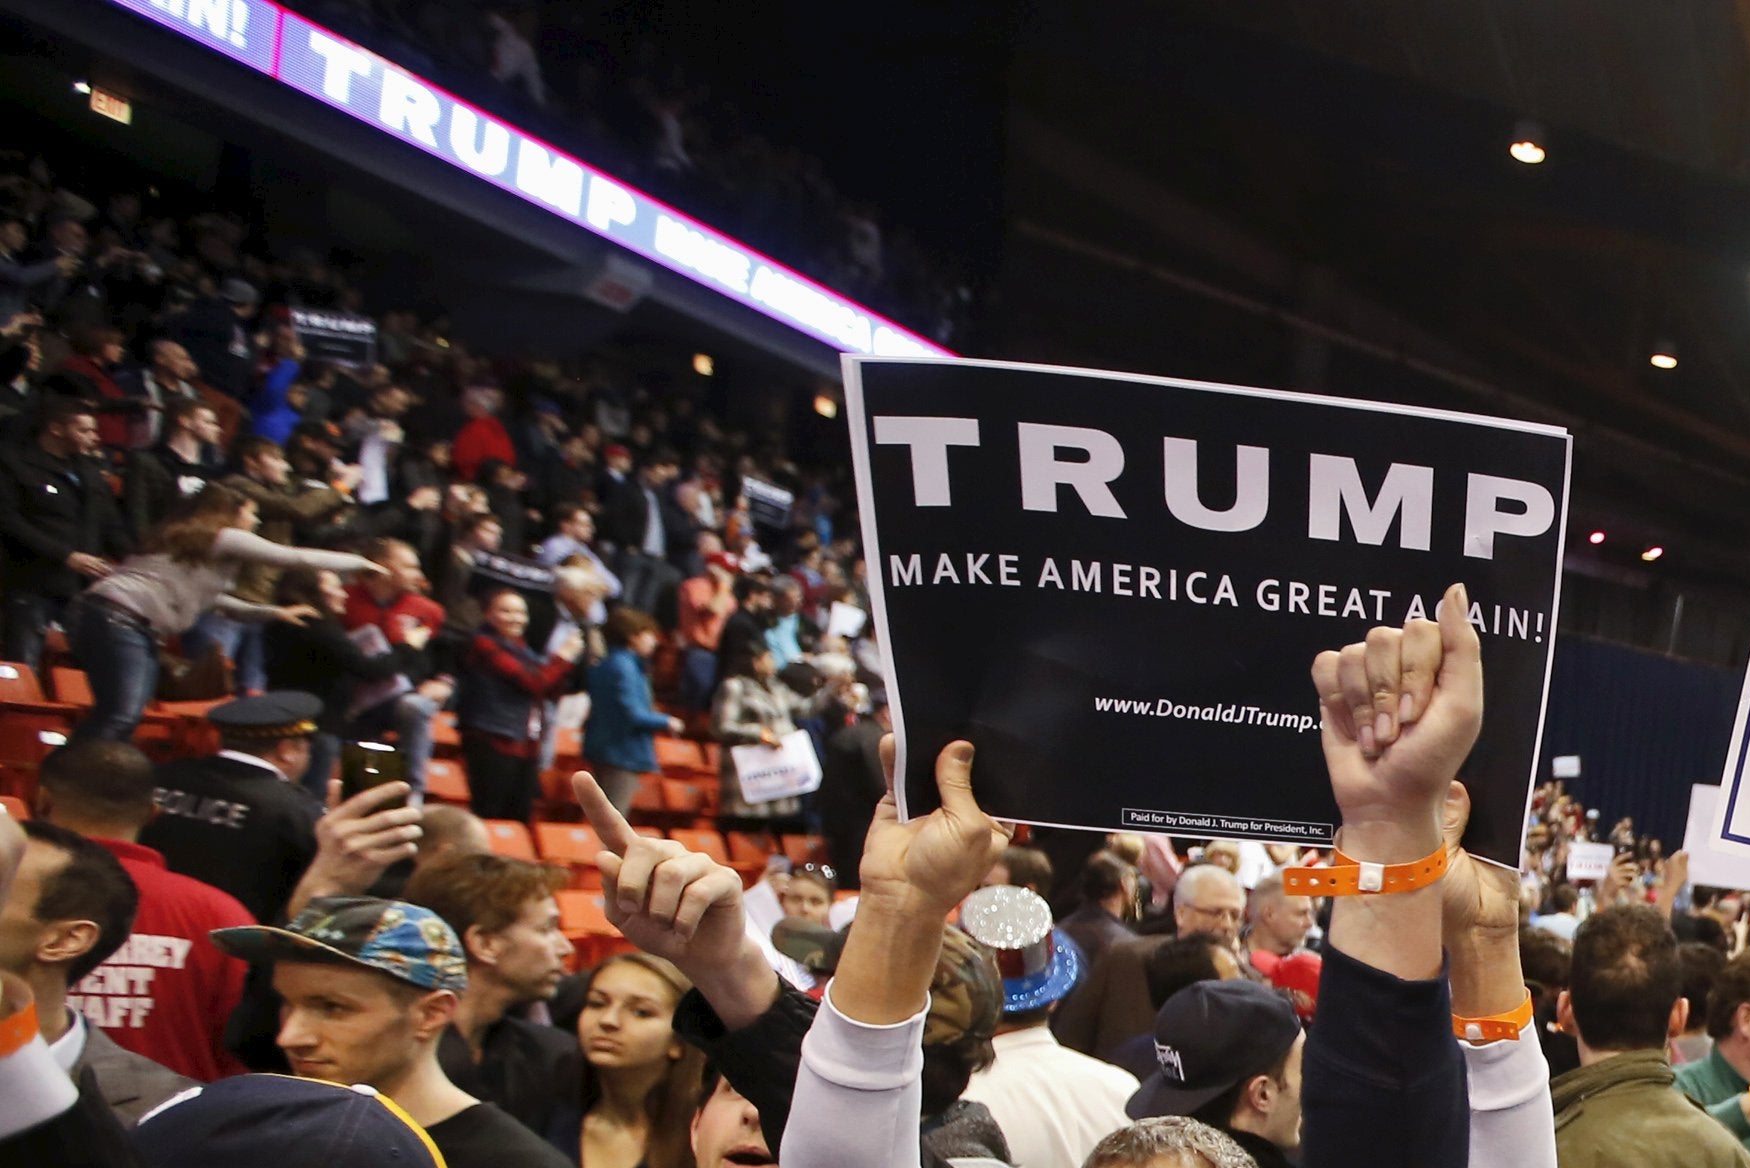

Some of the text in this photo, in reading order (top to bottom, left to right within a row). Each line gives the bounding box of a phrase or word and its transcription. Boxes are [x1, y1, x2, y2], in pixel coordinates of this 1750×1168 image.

[308, 30, 637, 233] TRUMP
[873, 415, 1554, 560] TRUMP
[890, 554, 1544, 643] MAKE AMERICA GREAT AAIN!
[153, 786, 250, 829] POLICE
[1131, 812, 1325, 835] Paid for by Donald J. Trump for President, Inc.
